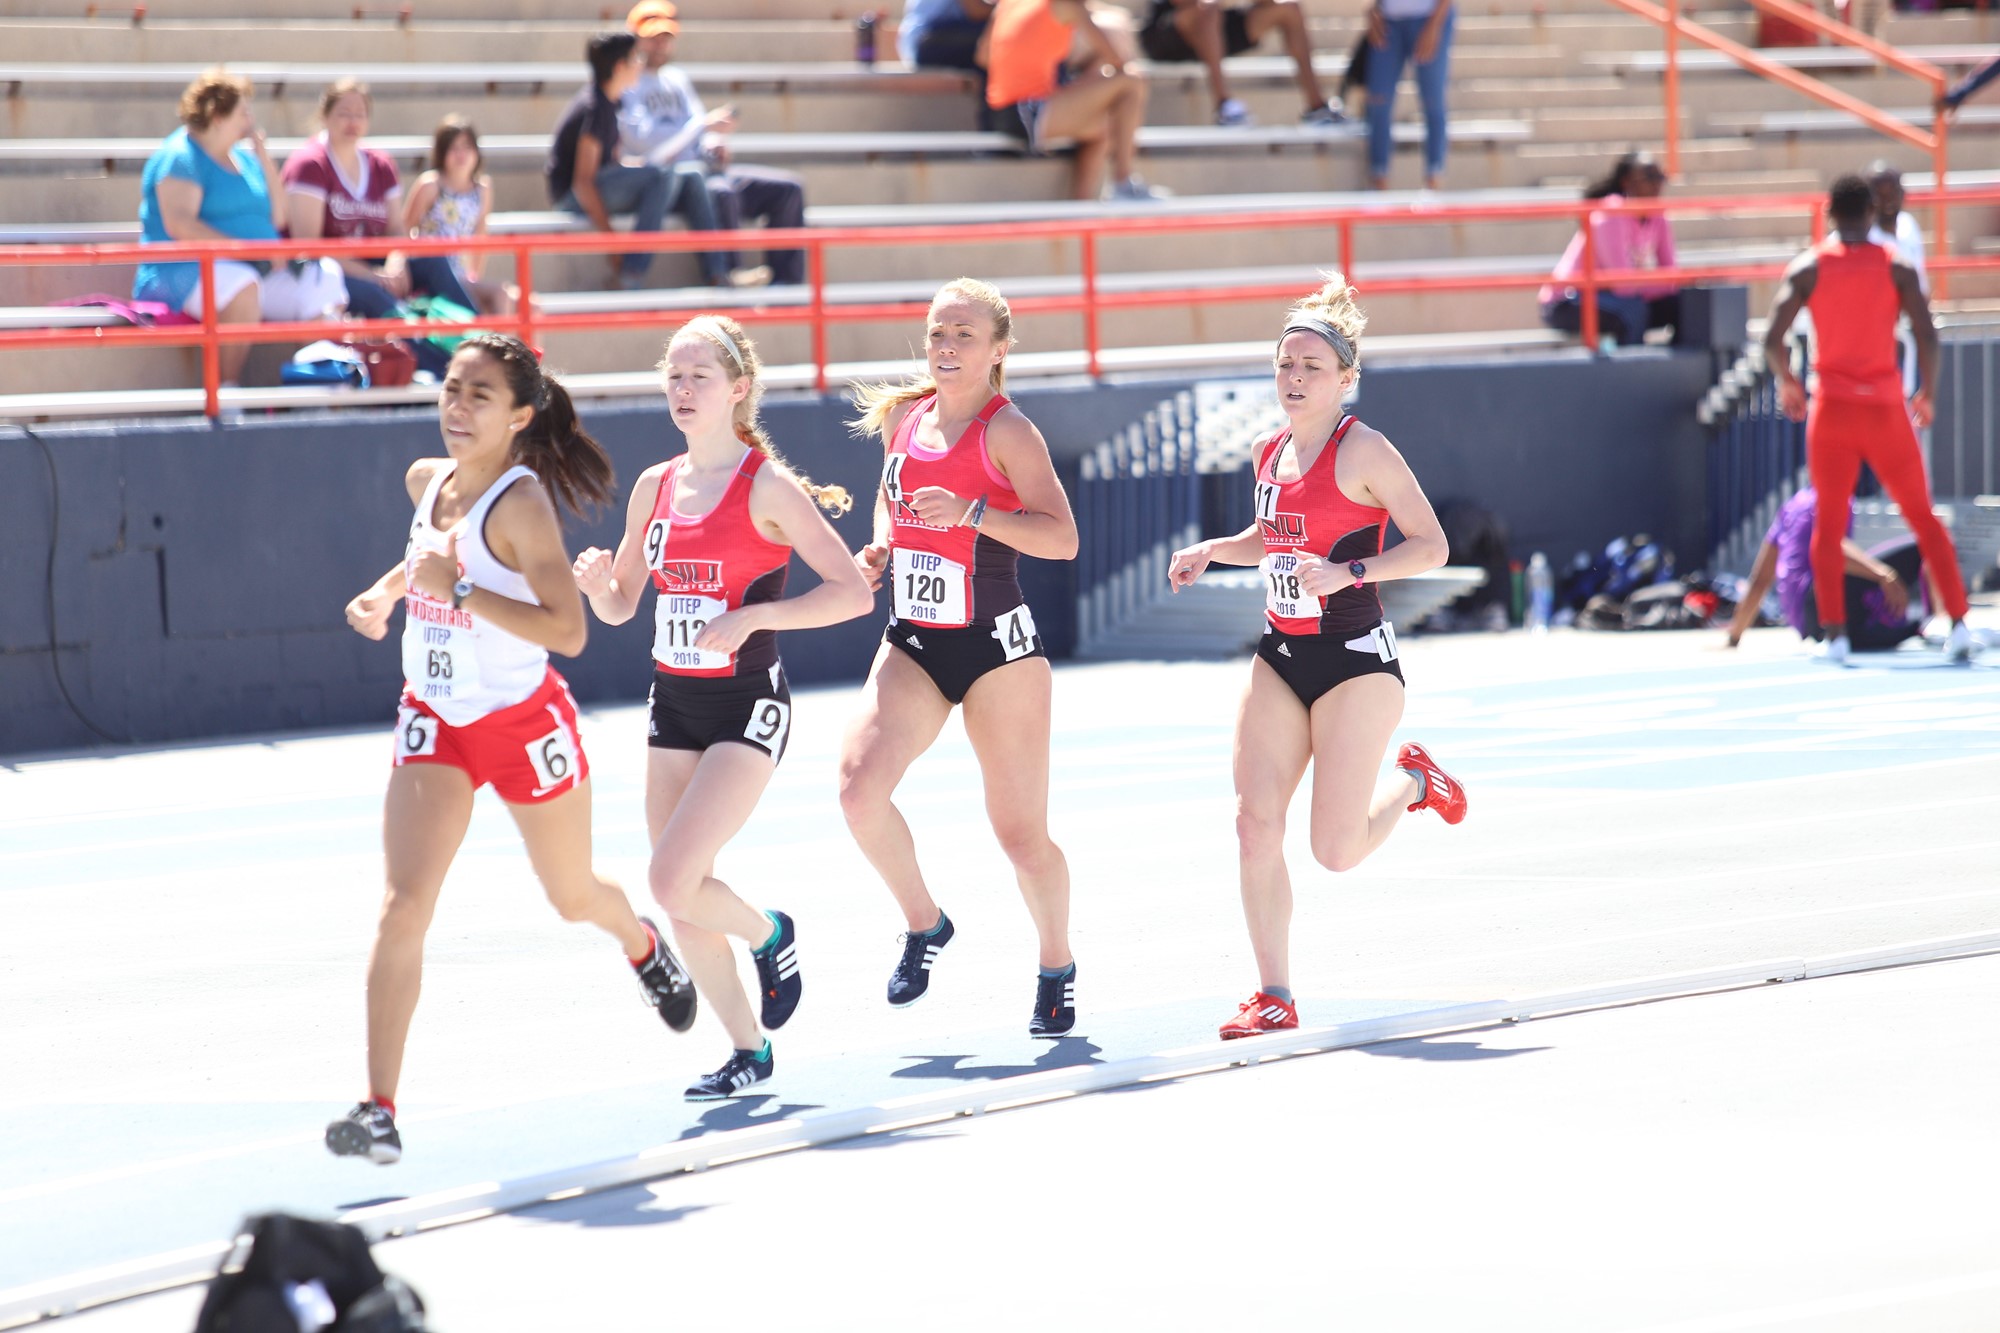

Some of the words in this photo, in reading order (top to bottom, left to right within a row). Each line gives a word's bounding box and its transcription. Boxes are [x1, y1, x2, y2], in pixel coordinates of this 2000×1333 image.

[886, 456, 899, 499] 4
[1256, 483, 1273, 518] 11
[649, 522, 663, 567] 9
[911, 553, 942, 572] UTEP
[1274, 555, 1297, 572] UTEP
[905, 573, 946, 604] 120
[1269, 572, 1301, 600] 118
[670, 597, 702, 615] UTEP
[910, 604, 937, 620] 2016
[1275, 602, 1297, 616] 2016
[423, 626, 452, 645] UTEP
[1008, 612, 1029, 652] 4
[426, 649, 453, 679] 63
[672, 652, 701, 666] 2016
[405, 713, 428, 753] 6
[755, 703, 782, 742] 9
[541, 737, 568, 779] 6
